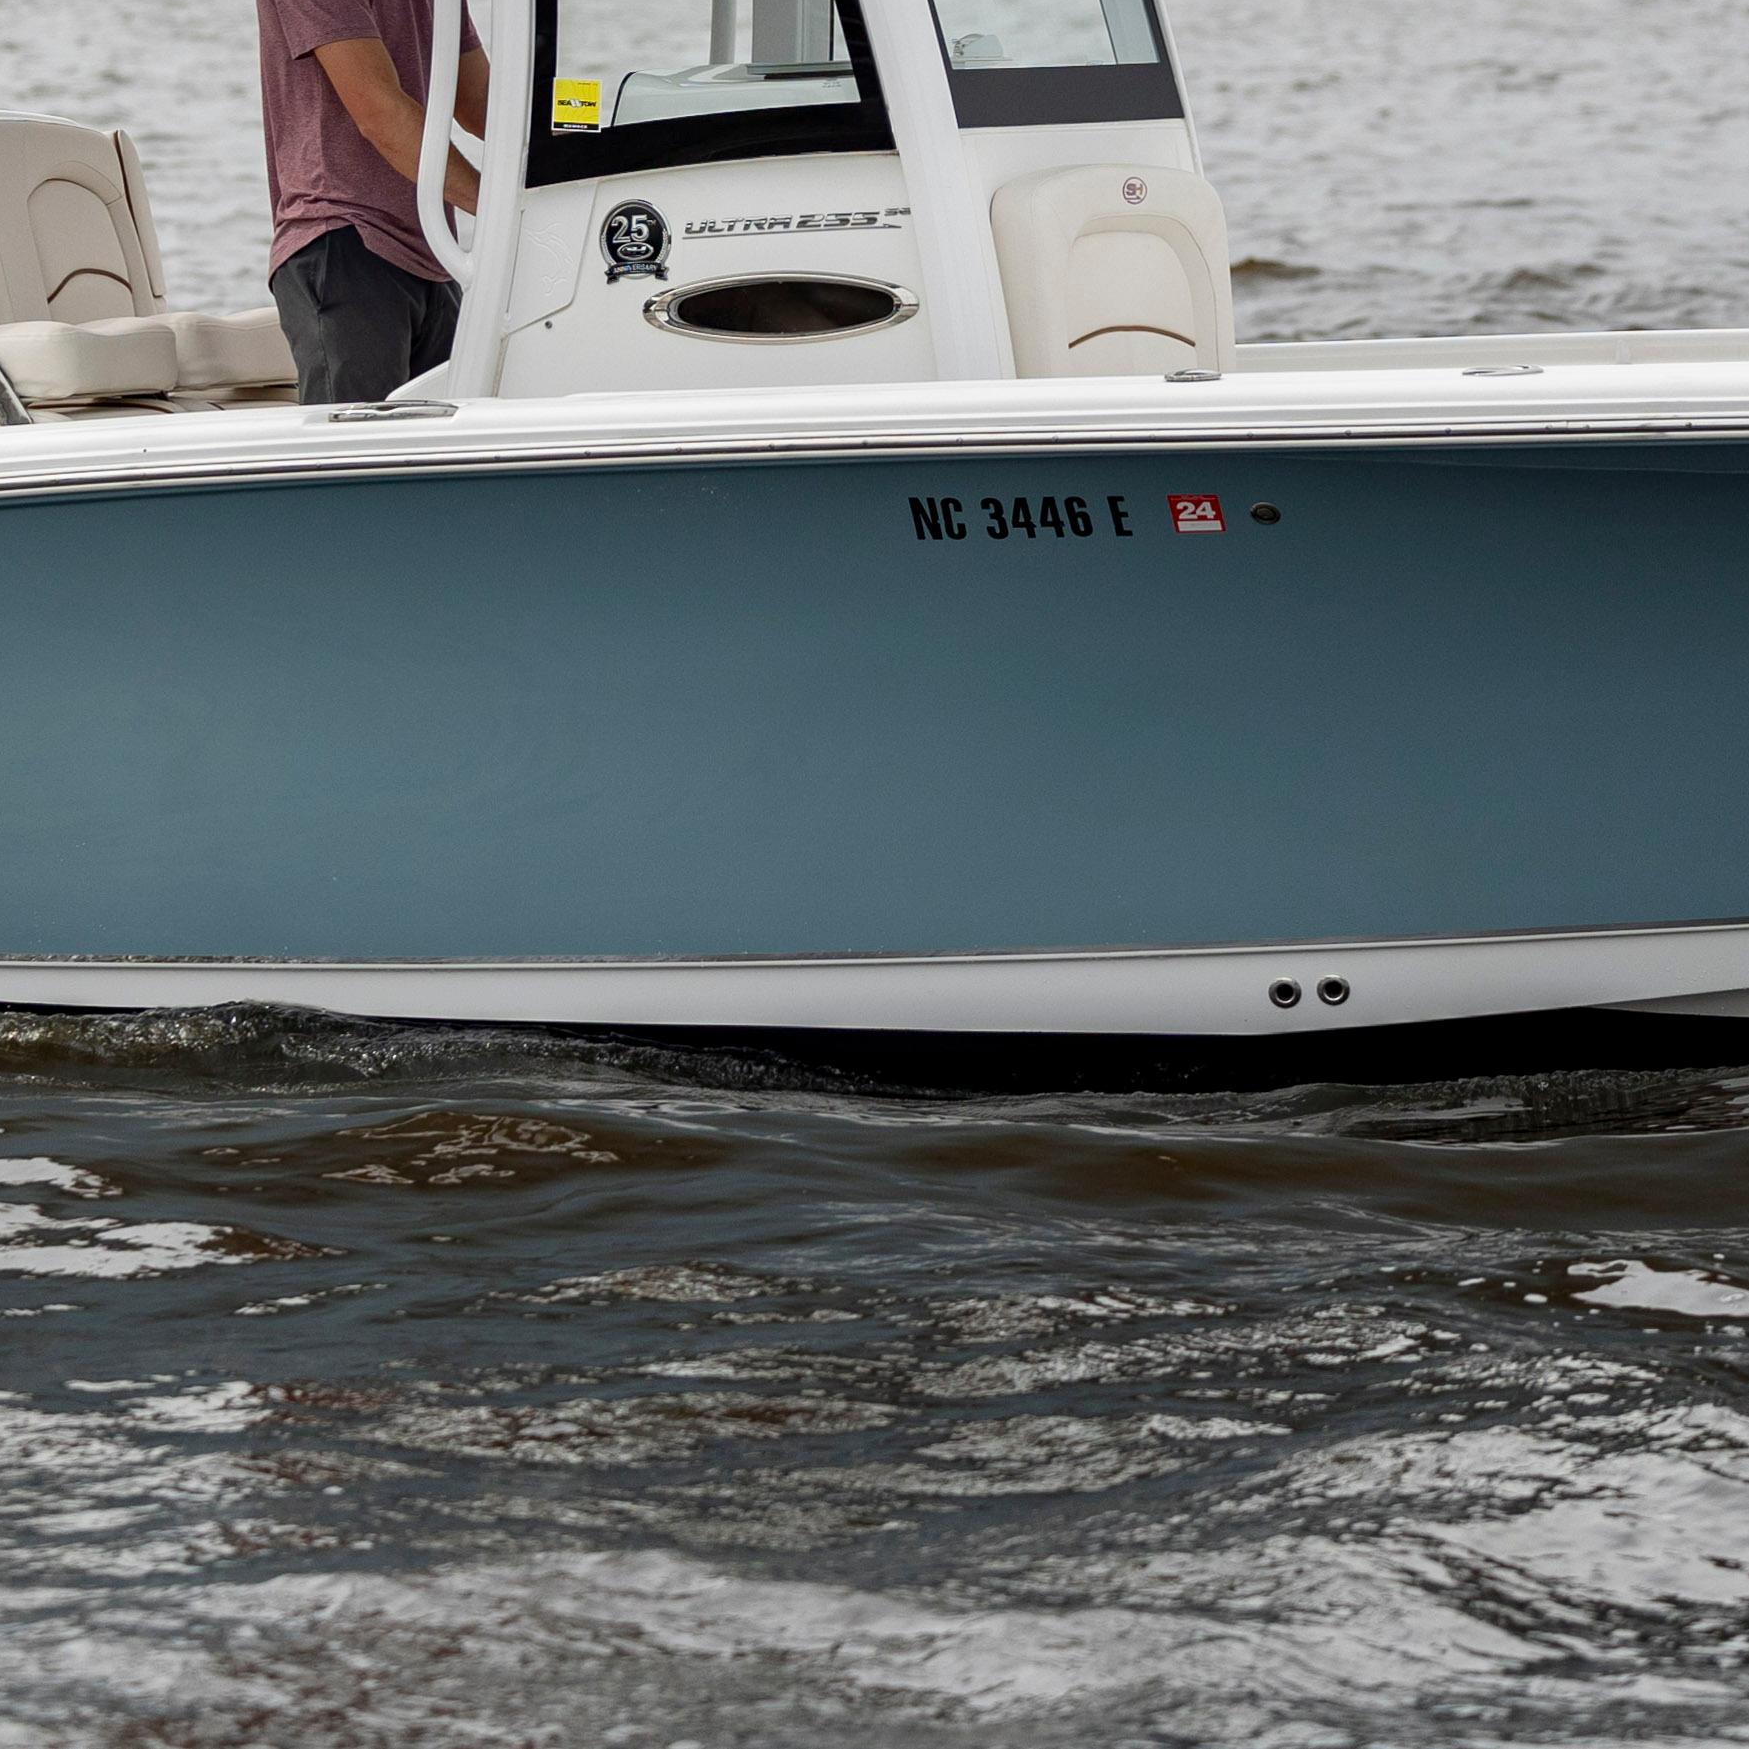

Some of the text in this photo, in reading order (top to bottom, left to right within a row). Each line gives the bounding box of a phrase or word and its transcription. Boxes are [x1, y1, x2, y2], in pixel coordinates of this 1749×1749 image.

[684, 215, 793, 235] ULTRA
[796, 211, 880, 230] 255
[908, 495, 1134, 540] NC 3446 E
[1176, 501, 1216, 520] 24
